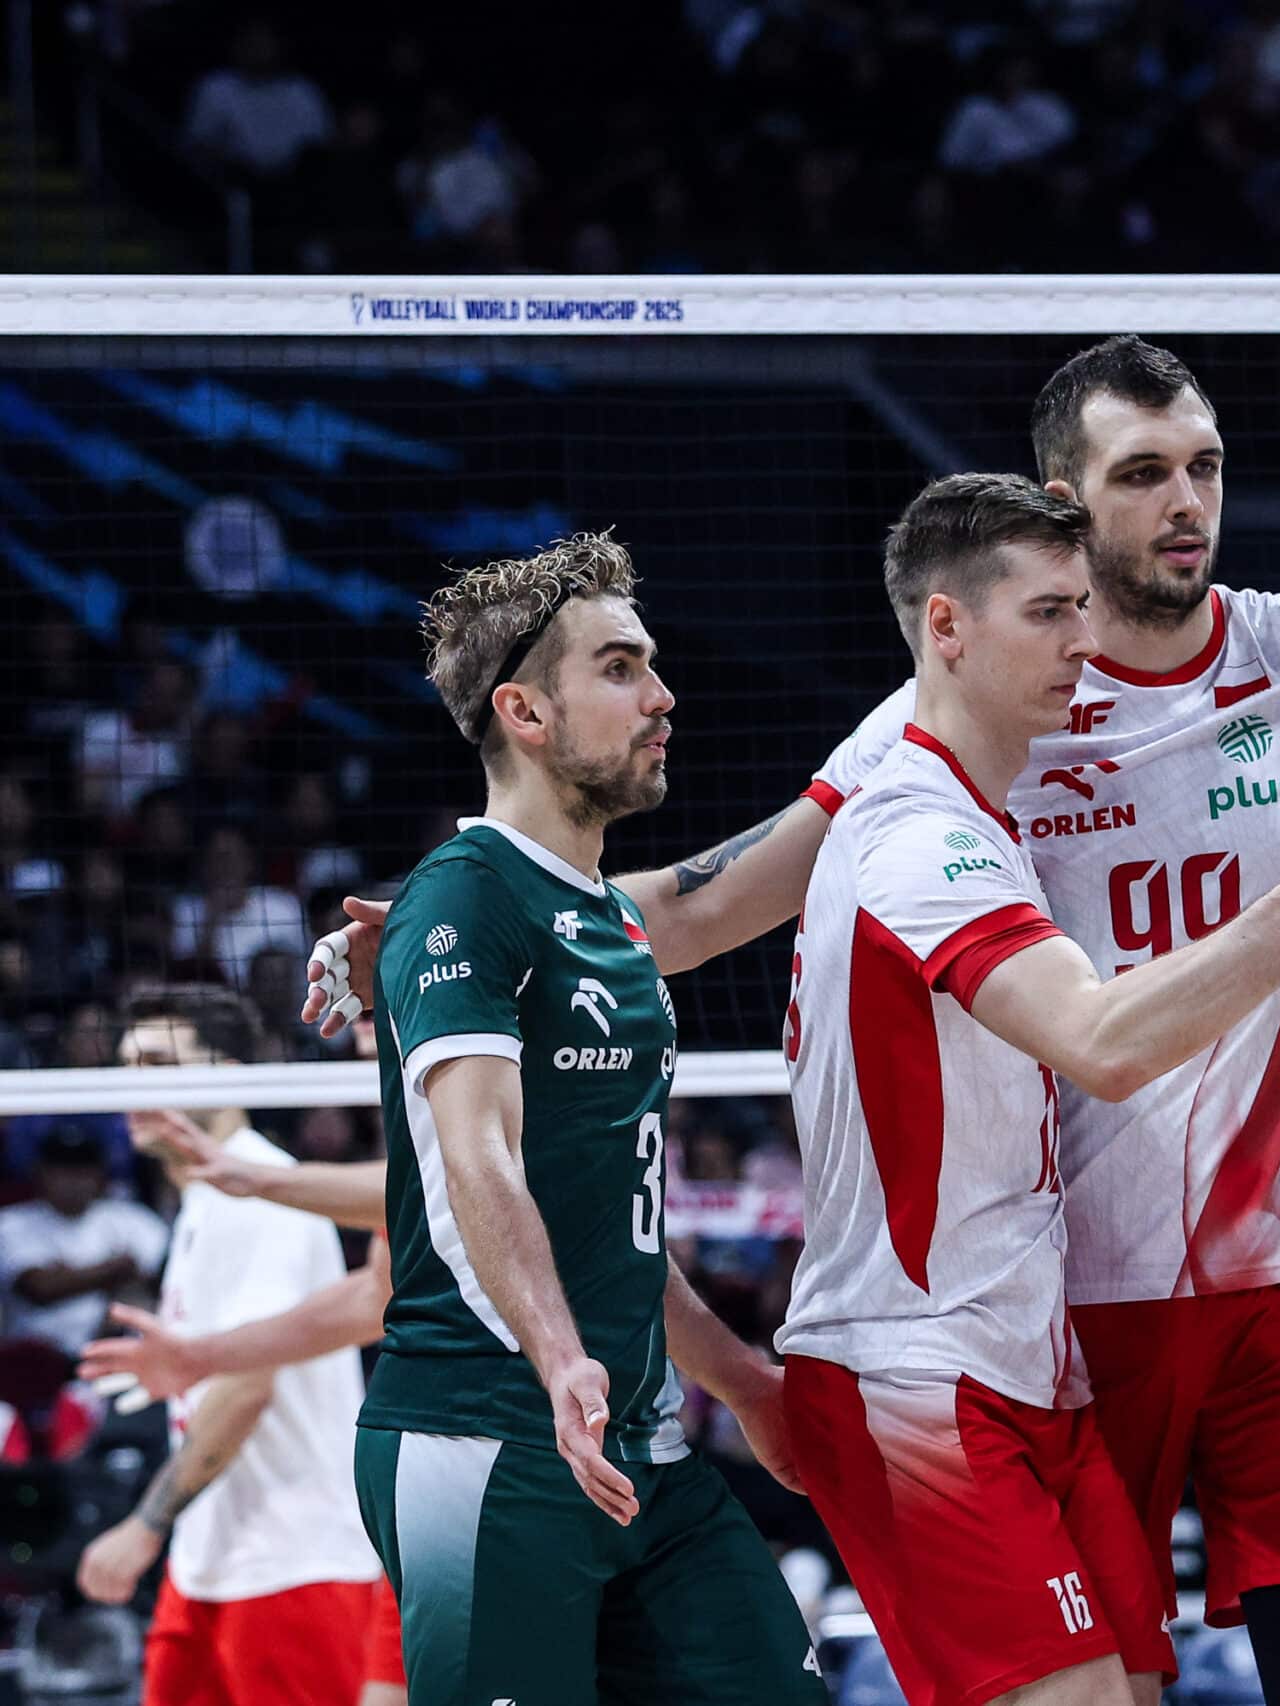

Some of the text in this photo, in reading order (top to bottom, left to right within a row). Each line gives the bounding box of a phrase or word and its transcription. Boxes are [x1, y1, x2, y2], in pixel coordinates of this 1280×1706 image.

[370, 299, 456, 320] VOLLEYBALL
[464, 299, 520, 320] WORLD
[526, 299, 638, 320] CHAMPIONSHIP
[1030, 803, 1137, 839] ORLEN
[418, 960, 473, 995] plus
[553, 1047, 633, 1071] ORLEN
[632, 1112, 664, 1254] 3
[1046, 1571, 1093, 1635] 16
